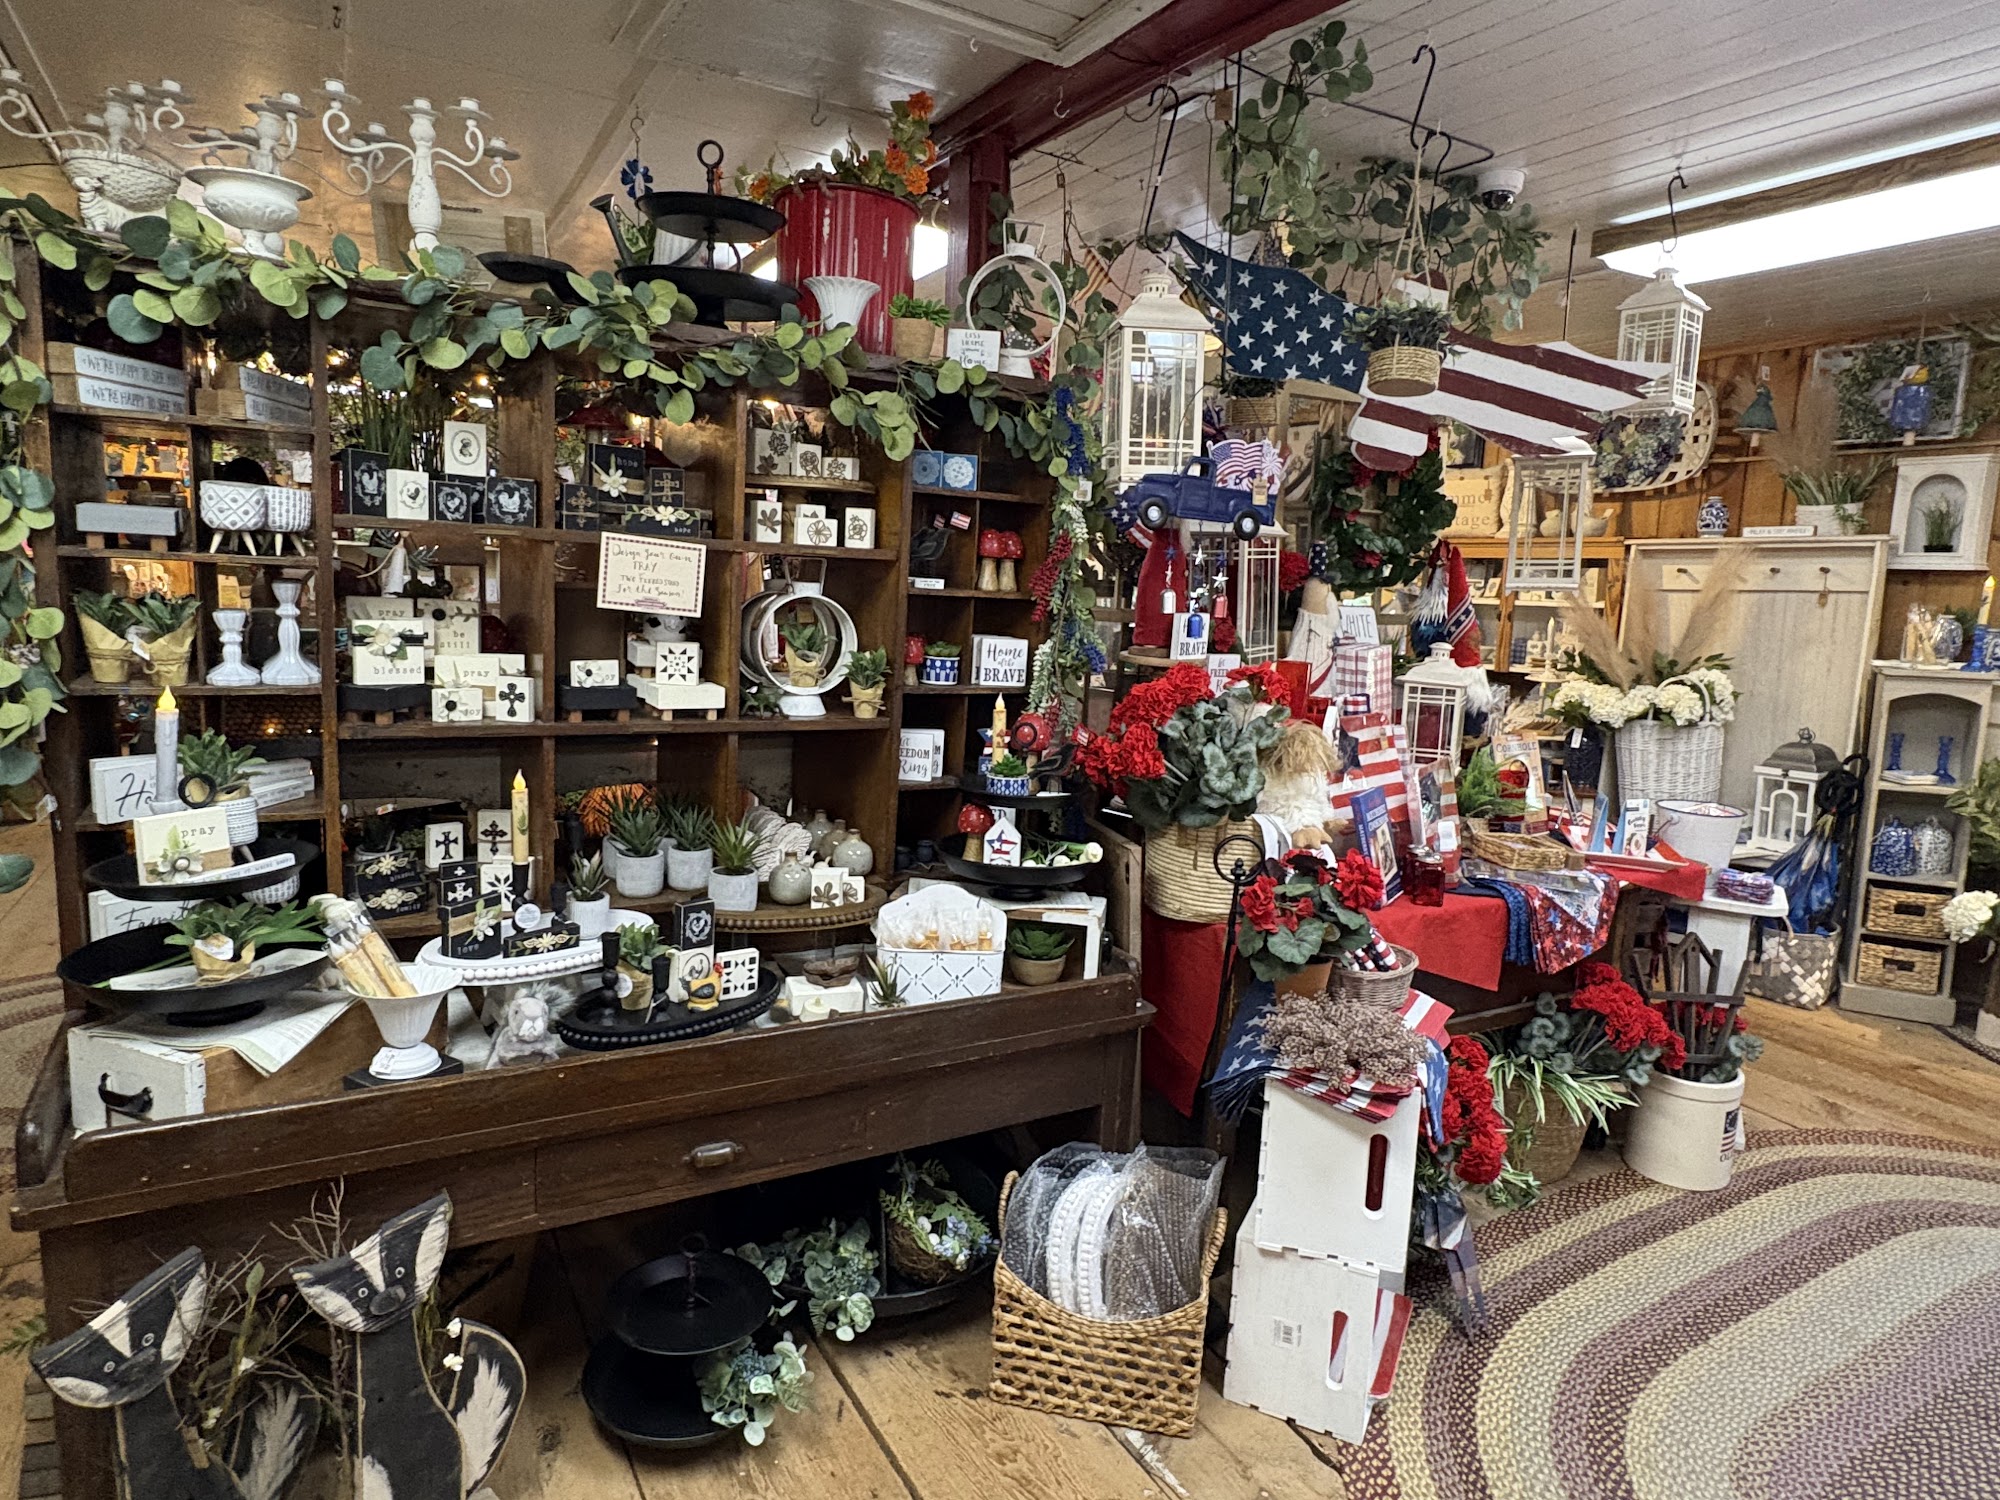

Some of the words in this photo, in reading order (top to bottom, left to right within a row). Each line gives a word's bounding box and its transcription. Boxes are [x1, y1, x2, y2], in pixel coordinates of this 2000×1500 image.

[1456, 516, 1491, 530] tage
[674, 526, 691, 534] hope
[633, 560, 658, 573] TRAY
[378, 608, 406, 618] pray
[453, 630, 466, 639] be
[439, 641, 471, 649] still
[1179, 641, 1207, 656] BRAVE
[987, 643, 1024, 662] Home
[373, 666, 422, 676] blessed
[463, 669, 491, 679] pray
[982, 667, 1025, 683] BRAVE
[1210, 668, 1229, 678] FREE
[604, 673, 617, 681] oy
[463, 708, 482, 718] joy
[899, 747, 930, 760] EEDOM
[181, 825, 216, 839] pray
[457, 943, 480, 956] love
